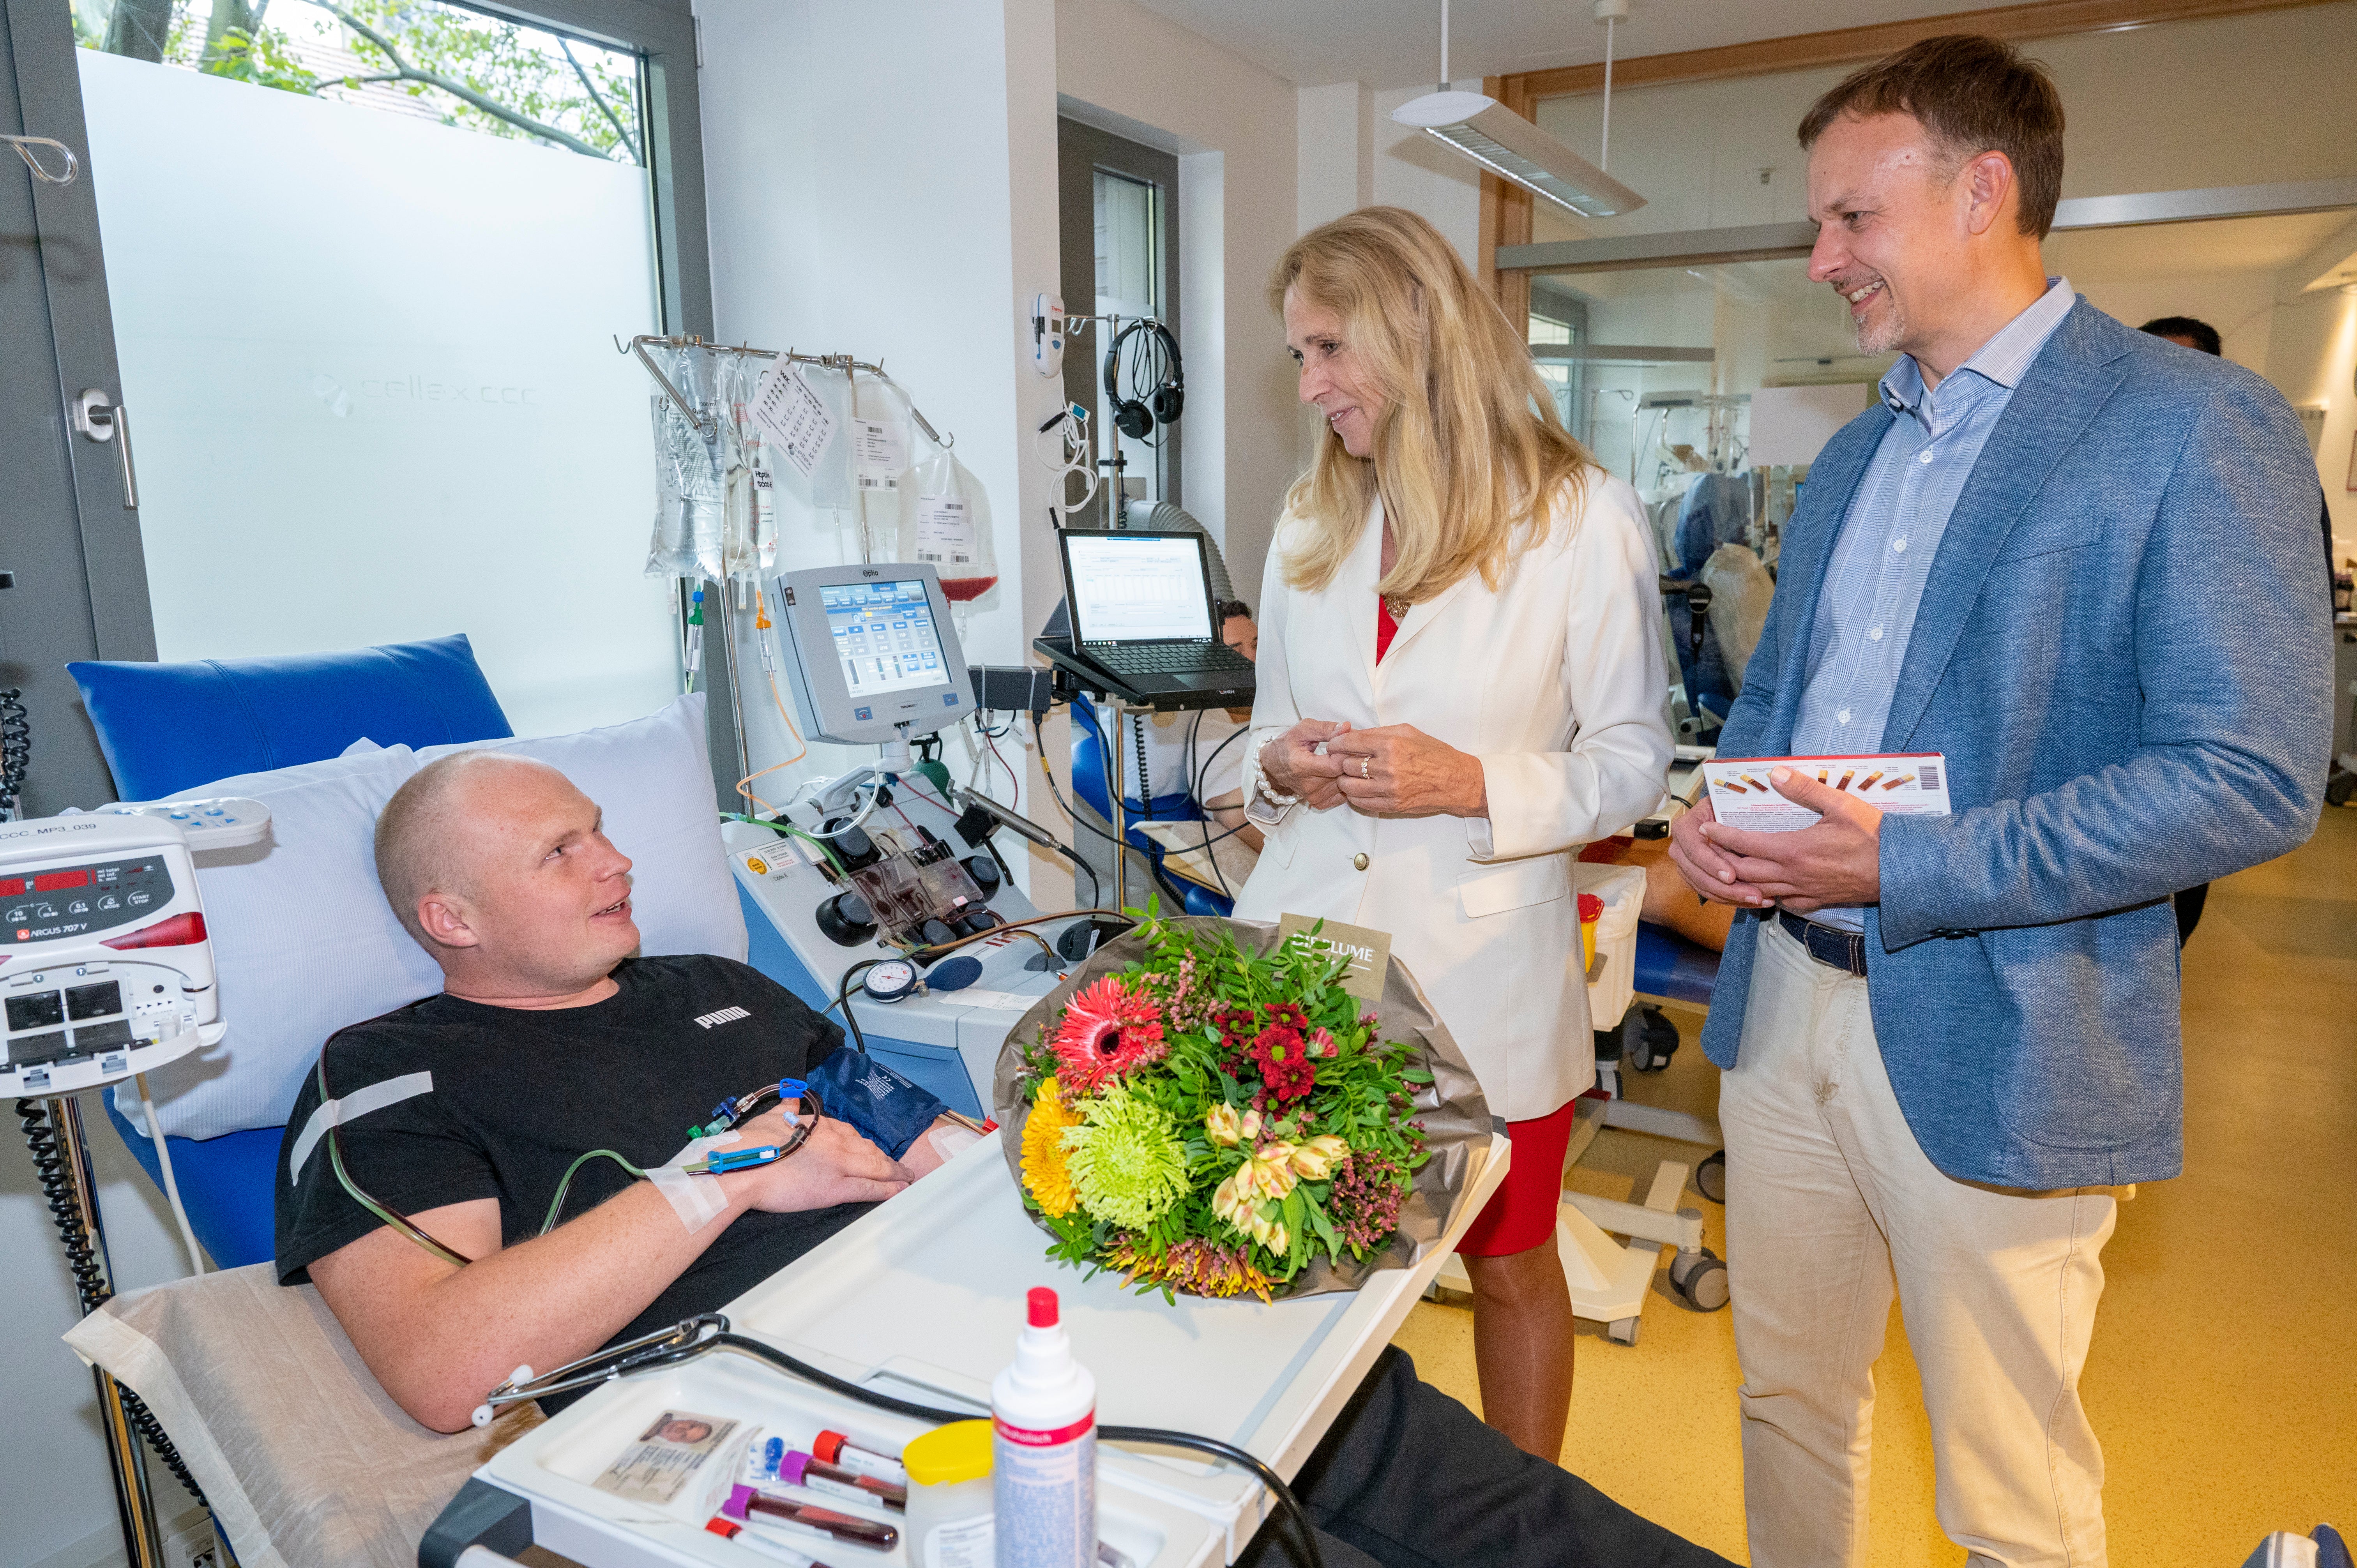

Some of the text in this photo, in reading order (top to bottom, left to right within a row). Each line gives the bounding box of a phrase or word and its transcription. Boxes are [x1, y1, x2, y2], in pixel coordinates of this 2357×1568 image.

[30, 926, 61, 937] ARGUS
[63, 924, 78, 933] 707
[694, 1006, 751, 1029] PUMA
